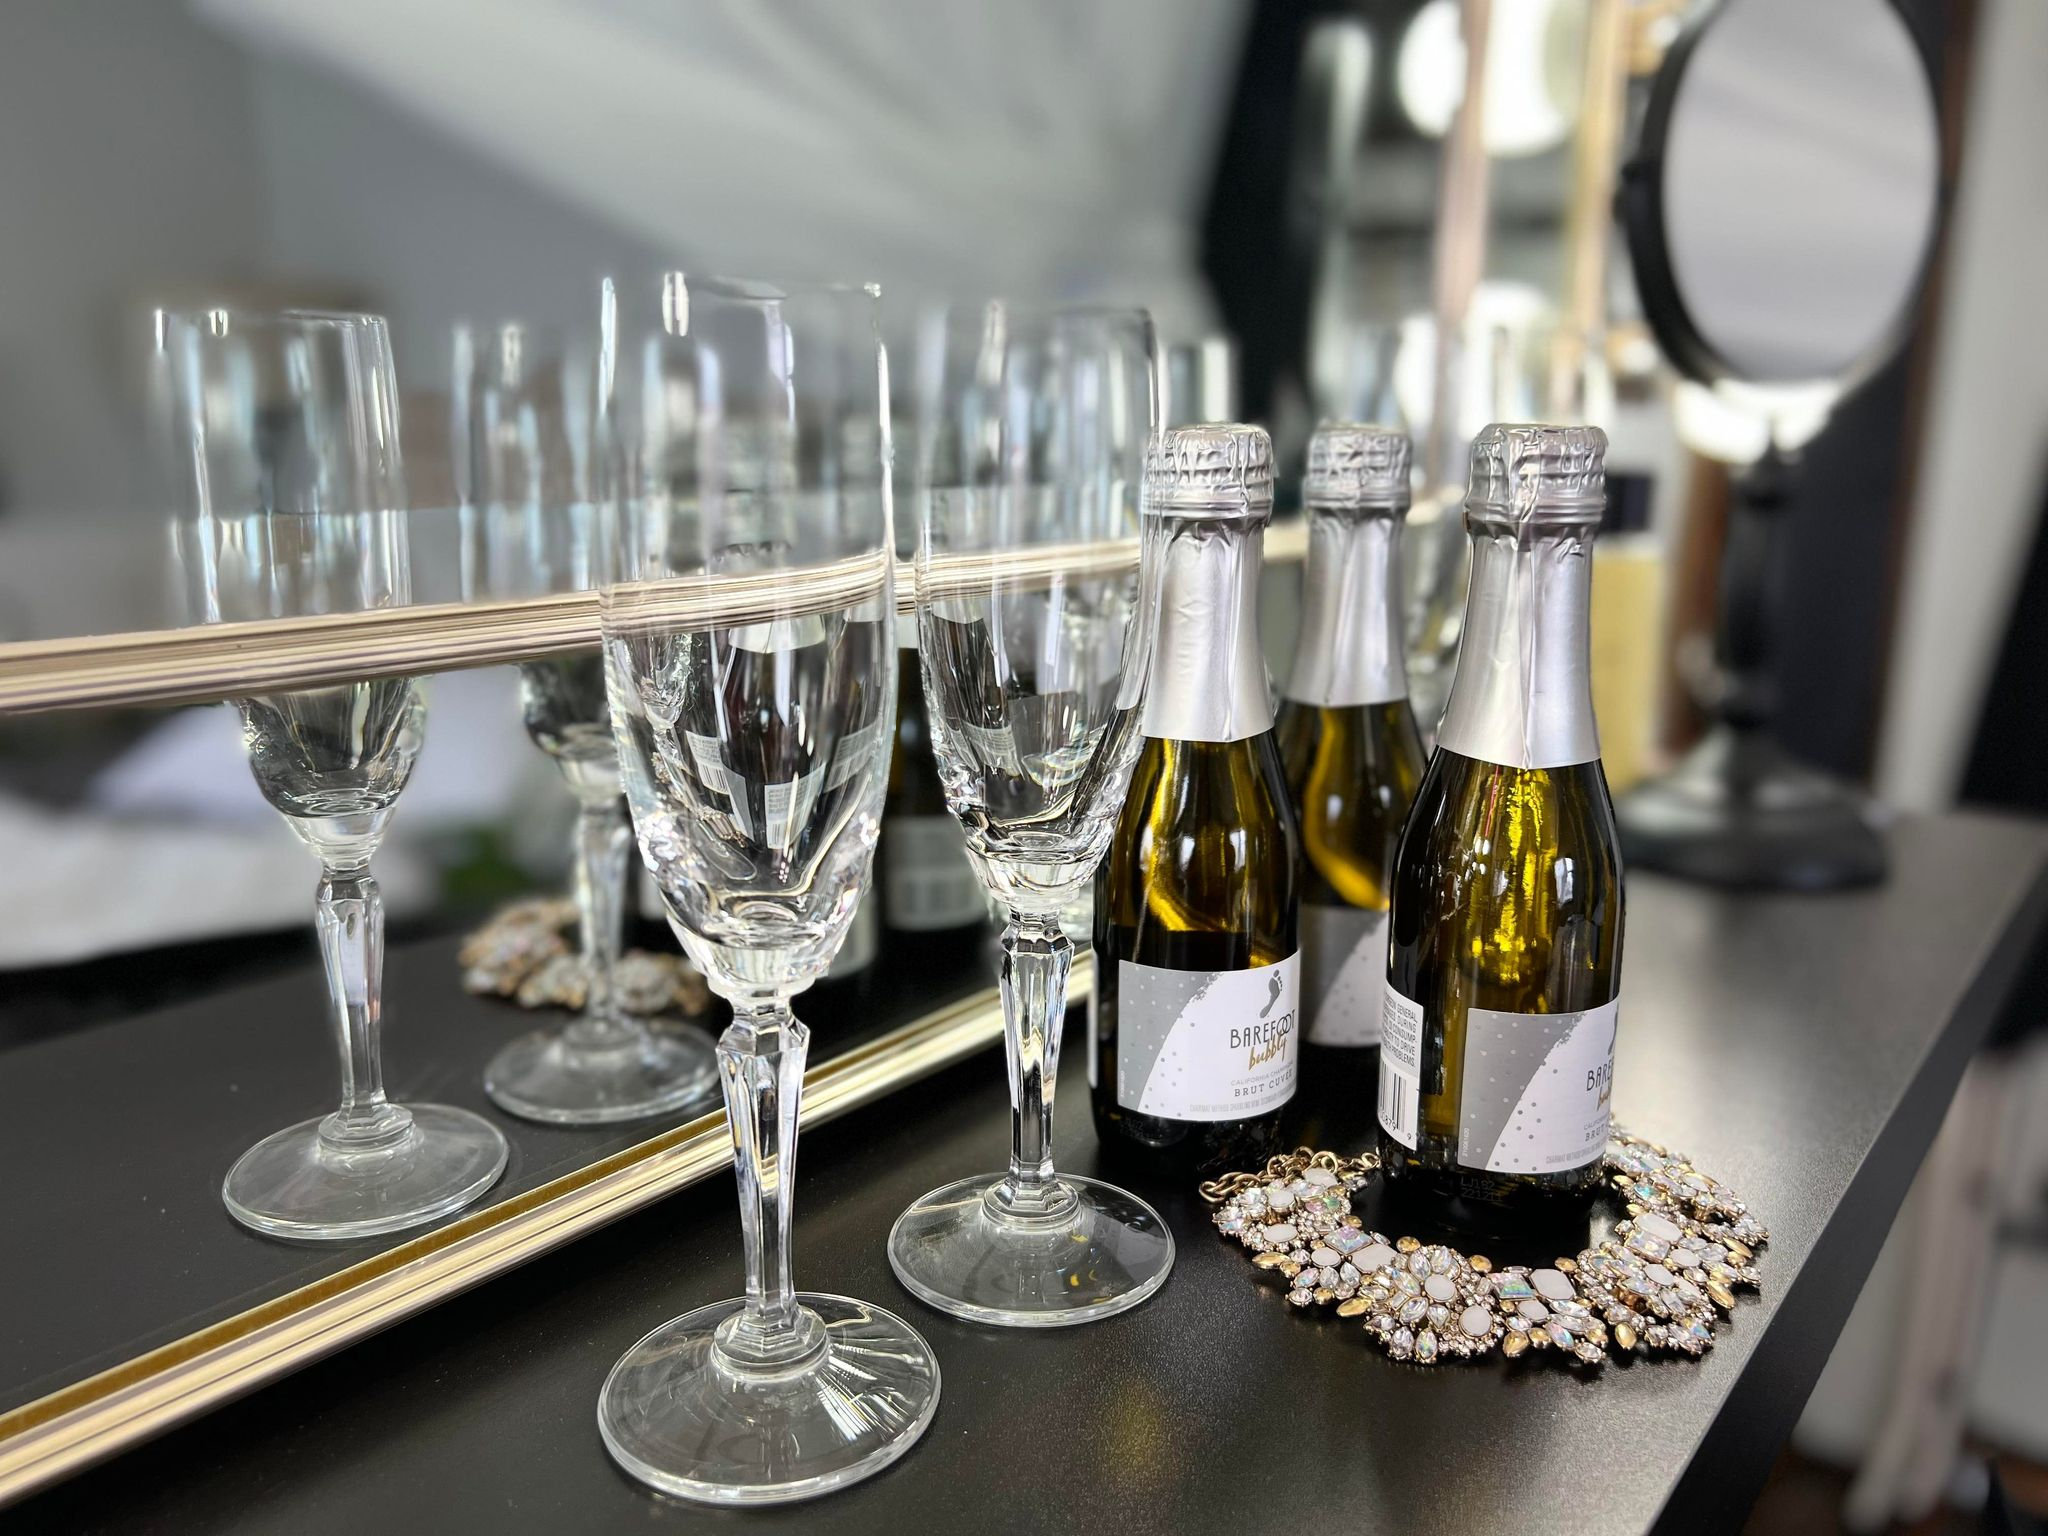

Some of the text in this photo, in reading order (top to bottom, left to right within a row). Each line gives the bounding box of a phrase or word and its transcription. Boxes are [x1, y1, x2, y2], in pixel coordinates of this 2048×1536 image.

[1230, 1008, 1296, 1049] BAREFOOT
[1248, 1029, 1287, 1071] bubbly
[1234, 1083, 1265, 1097] BRUT
